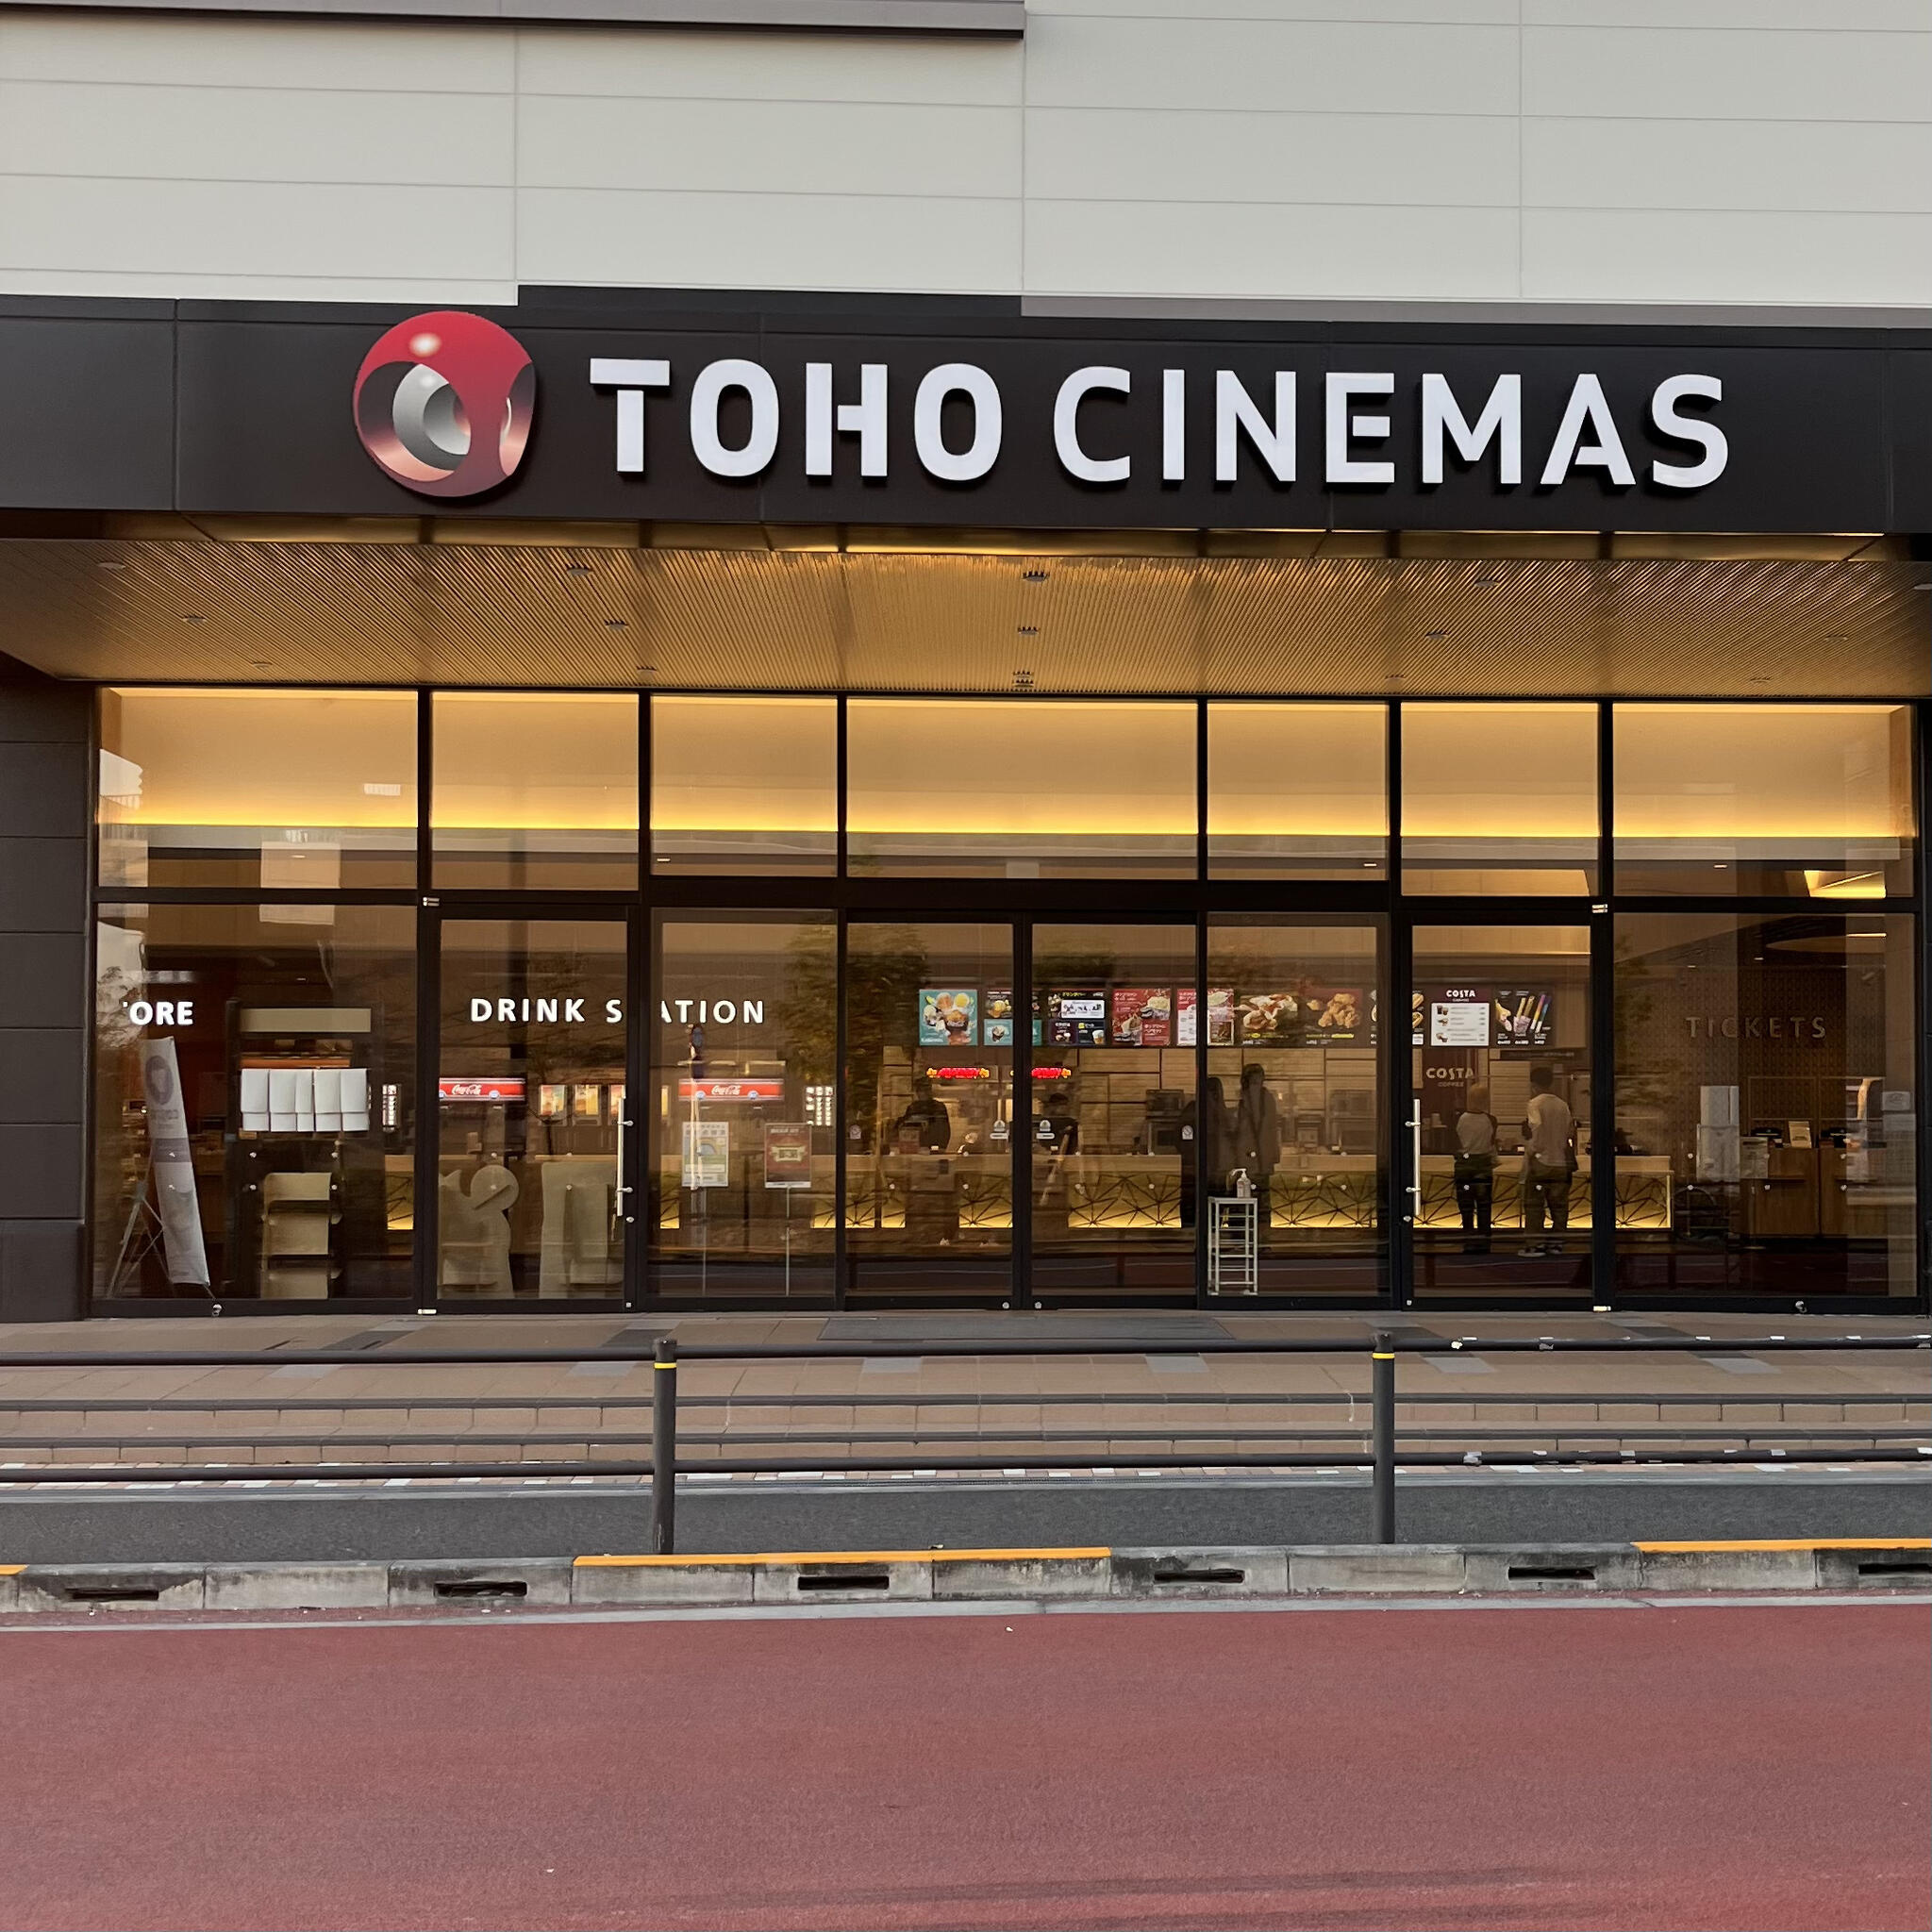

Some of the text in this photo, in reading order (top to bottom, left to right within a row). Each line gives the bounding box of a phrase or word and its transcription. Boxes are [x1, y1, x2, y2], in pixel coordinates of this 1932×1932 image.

[590, 358, 1729, 489] TOHO CINEMAS
[1446, 990, 1475, 998] COSTA
[471, 998, 765, 1024] DRINK SATION
[1685, 1016, 1826, 1039] TICKETS
[1425, 1067, 1474, 1080] COSTA
